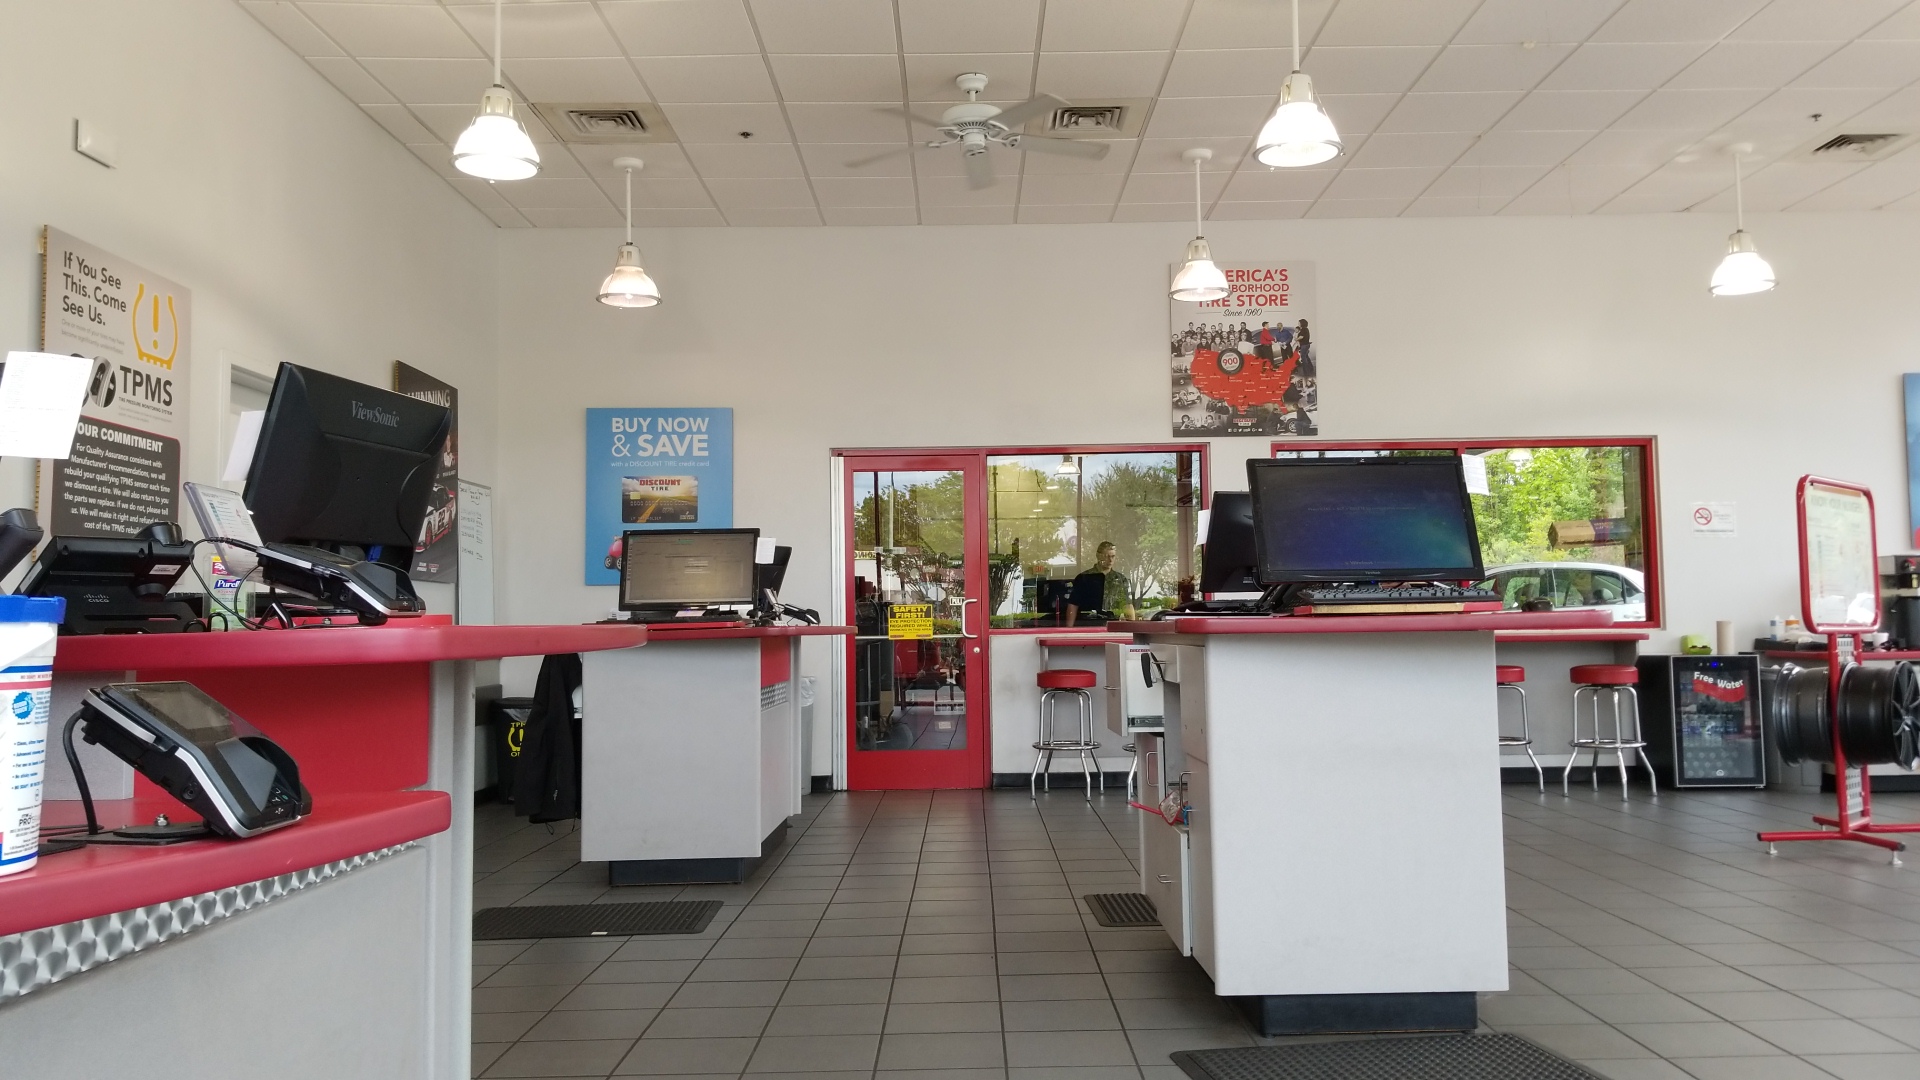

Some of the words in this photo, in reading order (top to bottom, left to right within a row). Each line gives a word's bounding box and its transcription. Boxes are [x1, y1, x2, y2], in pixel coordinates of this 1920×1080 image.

[63, 250, 73, 269] If
[76, 256, 97, 280] You
[101, 268, 122, 289] See
[1225, 269, 1288, 282] ERICA'S
[63, 272, 91, 298] This.
[94, 286, 127, 312] Come
[1228, 284, 1289, 293] BORHOOD
[62, 295, 84, 317] See
[88, 304, 106, 326] Us.
[1236, 294, 1288, 307] STORE
[1223, 309, 1242, 317] Since
[1244, 308, 1262, 317] 1960
[1222, 357, 1238, 366] 900
[120, 365, 172, 407] TPMS
[408, 390, 450, 408] NNING
[351, 400, 400, 428] ViewSonic
[612, 418, 652, 432] BUY
[658, 418, 709, 433] NOW
[77, 422, 99, 438] OUR
[101, 428, 163, 453] COMMITMENT
[612, 434, 631, 457] &
[637, 434, 709, 457] SAVE
[76, 443, 85, 452] For
[86, 445, 105, 458] Quality
[105, 450, 128, 461] Assurance
[130, 457, 152, 466] consistent
[71, 454, 108, 468] Manufacturers'
[109, 464, 150, 478] recommendations,
[64, 467, 82, 476] rebuild
[83, 472, 95, 480] your
[96, 473, 120, 485] qualifying
[120, 476, 134, 486] TPMS
[134, 481, 149, 489] sensor
[149, 483, 160, 491] each
[161, 485, 171, 493] time
[74, 480, 97, 492] dismount
[102, 486, 112, 494] tire.
[113, 487, 121, 496] We
[130, 491, 140, 499] also
[64, 492, 73, 500] the
[74, 495, 88, 503] parts
[97, 498, 116, 507] replace.
[116, 500, 121, 508] If
[130, 502, 136, 510] do
[137, 505, 145, 513] not,
[146, 505, 160, 514] please
[80, 507, 88, 516] We
[90, 508, 98, 517] will
[98, 510, 112, 519] make
[113, 512, 117, 520] it
[118, 513, 129, 522] right
[438, 510, 445, 530] 22
[102, 523, 110, 531] the
[111, 524, 125, 532] TPMS
[1694, 672, 1714, 684] Free
[1717, 679, 1744, 689] Water
